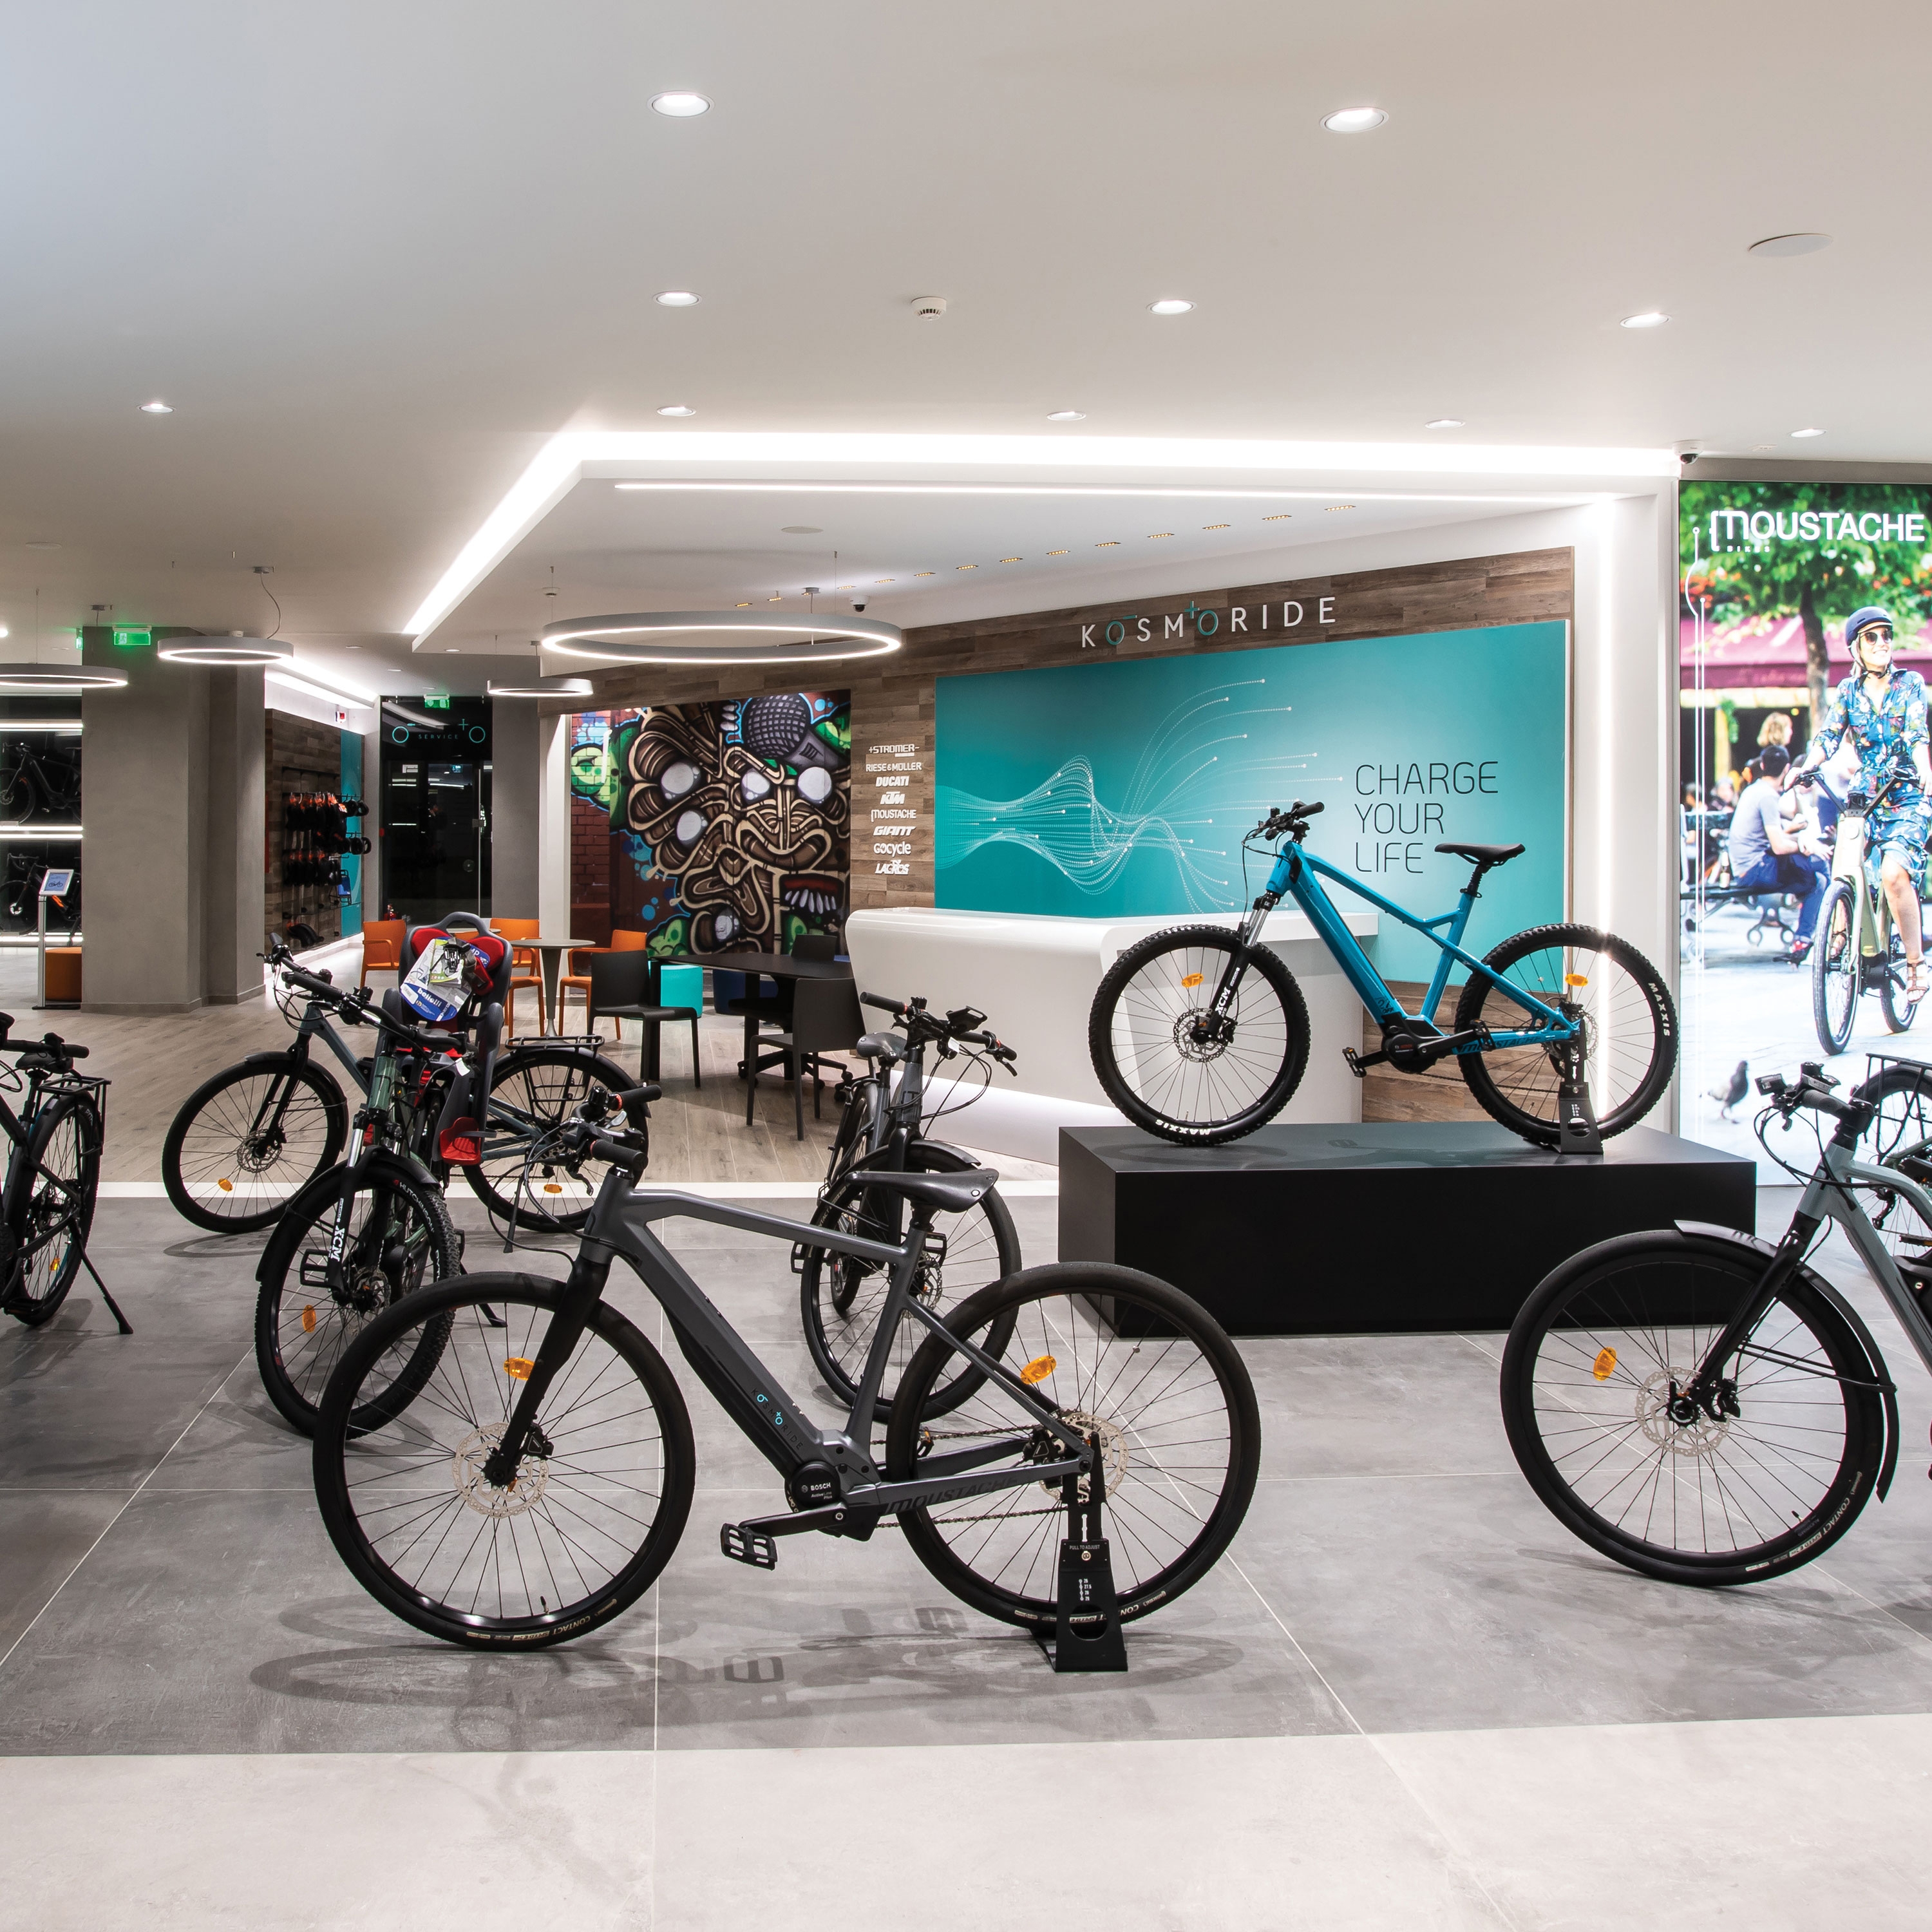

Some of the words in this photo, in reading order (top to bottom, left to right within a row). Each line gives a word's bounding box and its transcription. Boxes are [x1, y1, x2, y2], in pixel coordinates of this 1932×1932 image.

[1709, 510, 1925, 552] MOUSTACHE
[1081, 596, 1336, 648] KOSMORIDE
[876, 775, 910, 787] DUCATI
[1356, 761, 1499, 795] CHARGE
[880, 791, 905, 805] KTM
[871, 809, 917, 822] MOUSTACHE
[1354, 803, 1444, 834] YOUR
[873, 826, 916, 836] GIANT
[1356, 842, 1423, 873] LIFE
[1215, 986, 1231, 1016] XCM
[1648, 983, 1671, 1036] MAXXIS
[1462, 1036, 1542, 1054] MSTACHE
[1155, 1119, 1211, 1135] MAXXIS
[330, 1225, 345, 1262] XCM
[751, 1388, 804, 1450] KOSMORIDE
[810, 1482, 831, 1491] BOSCH
[1823, 1497, 1850, 1536] CONTACT
[553, 1615, 591, 1635] CONTACT
